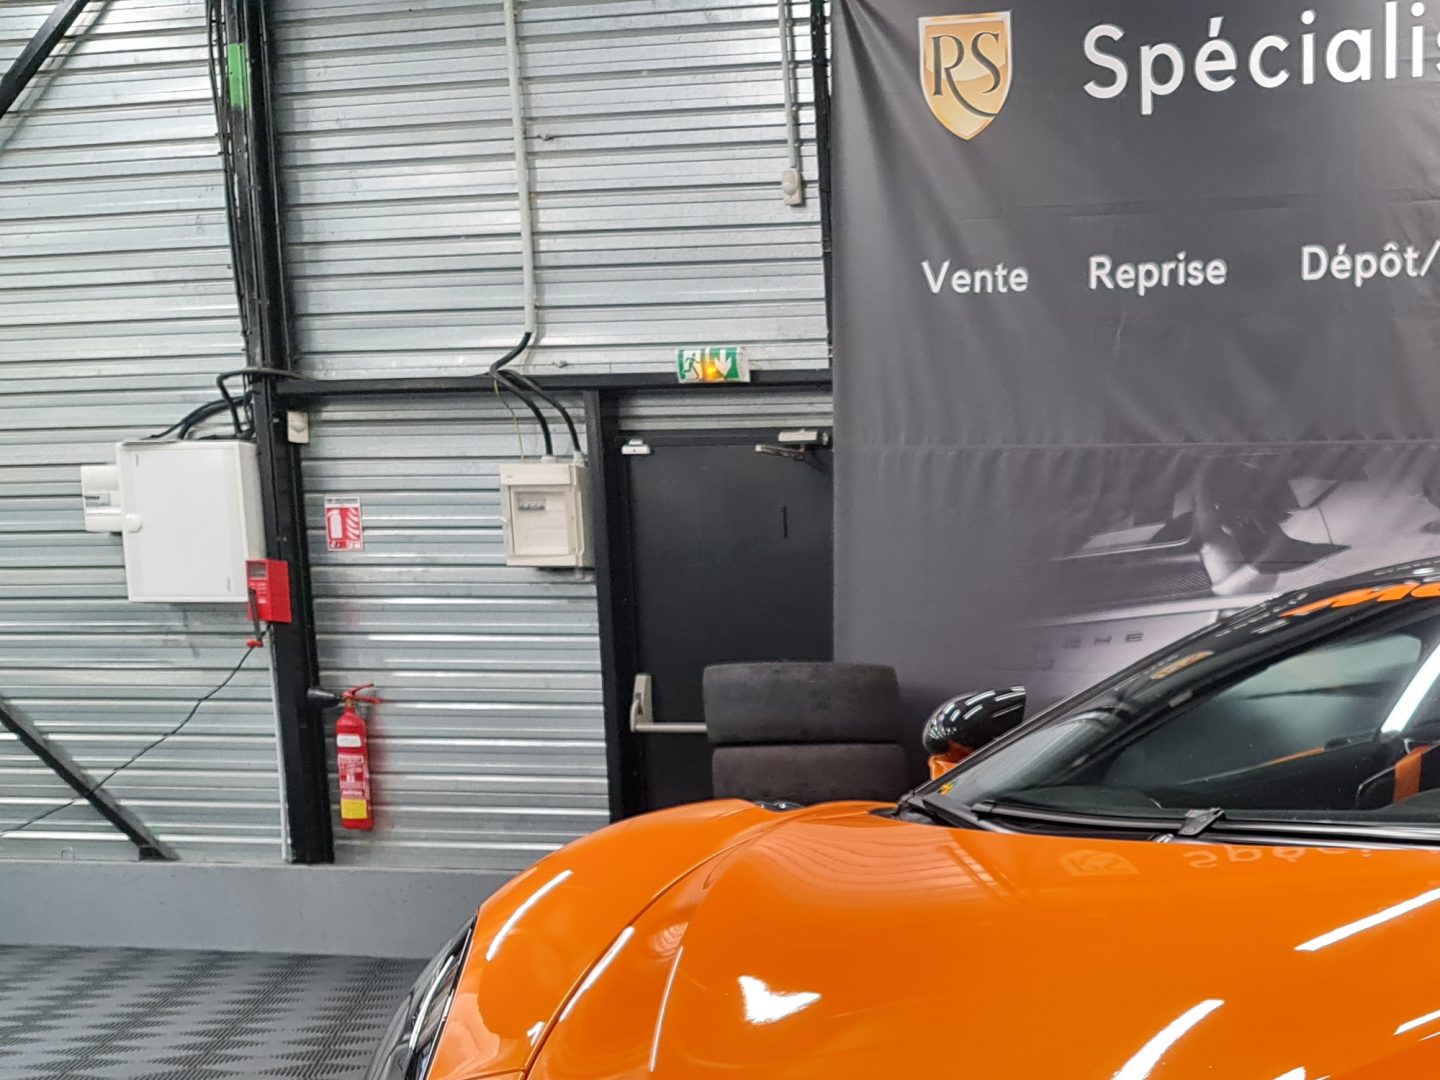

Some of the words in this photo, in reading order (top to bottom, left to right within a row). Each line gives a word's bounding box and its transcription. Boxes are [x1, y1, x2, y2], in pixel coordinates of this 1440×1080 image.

[930, 29, 1003, 118] RS
[921, 260, 1029, 295] Vente
[1089, 251, 1227, 297] Reprise
